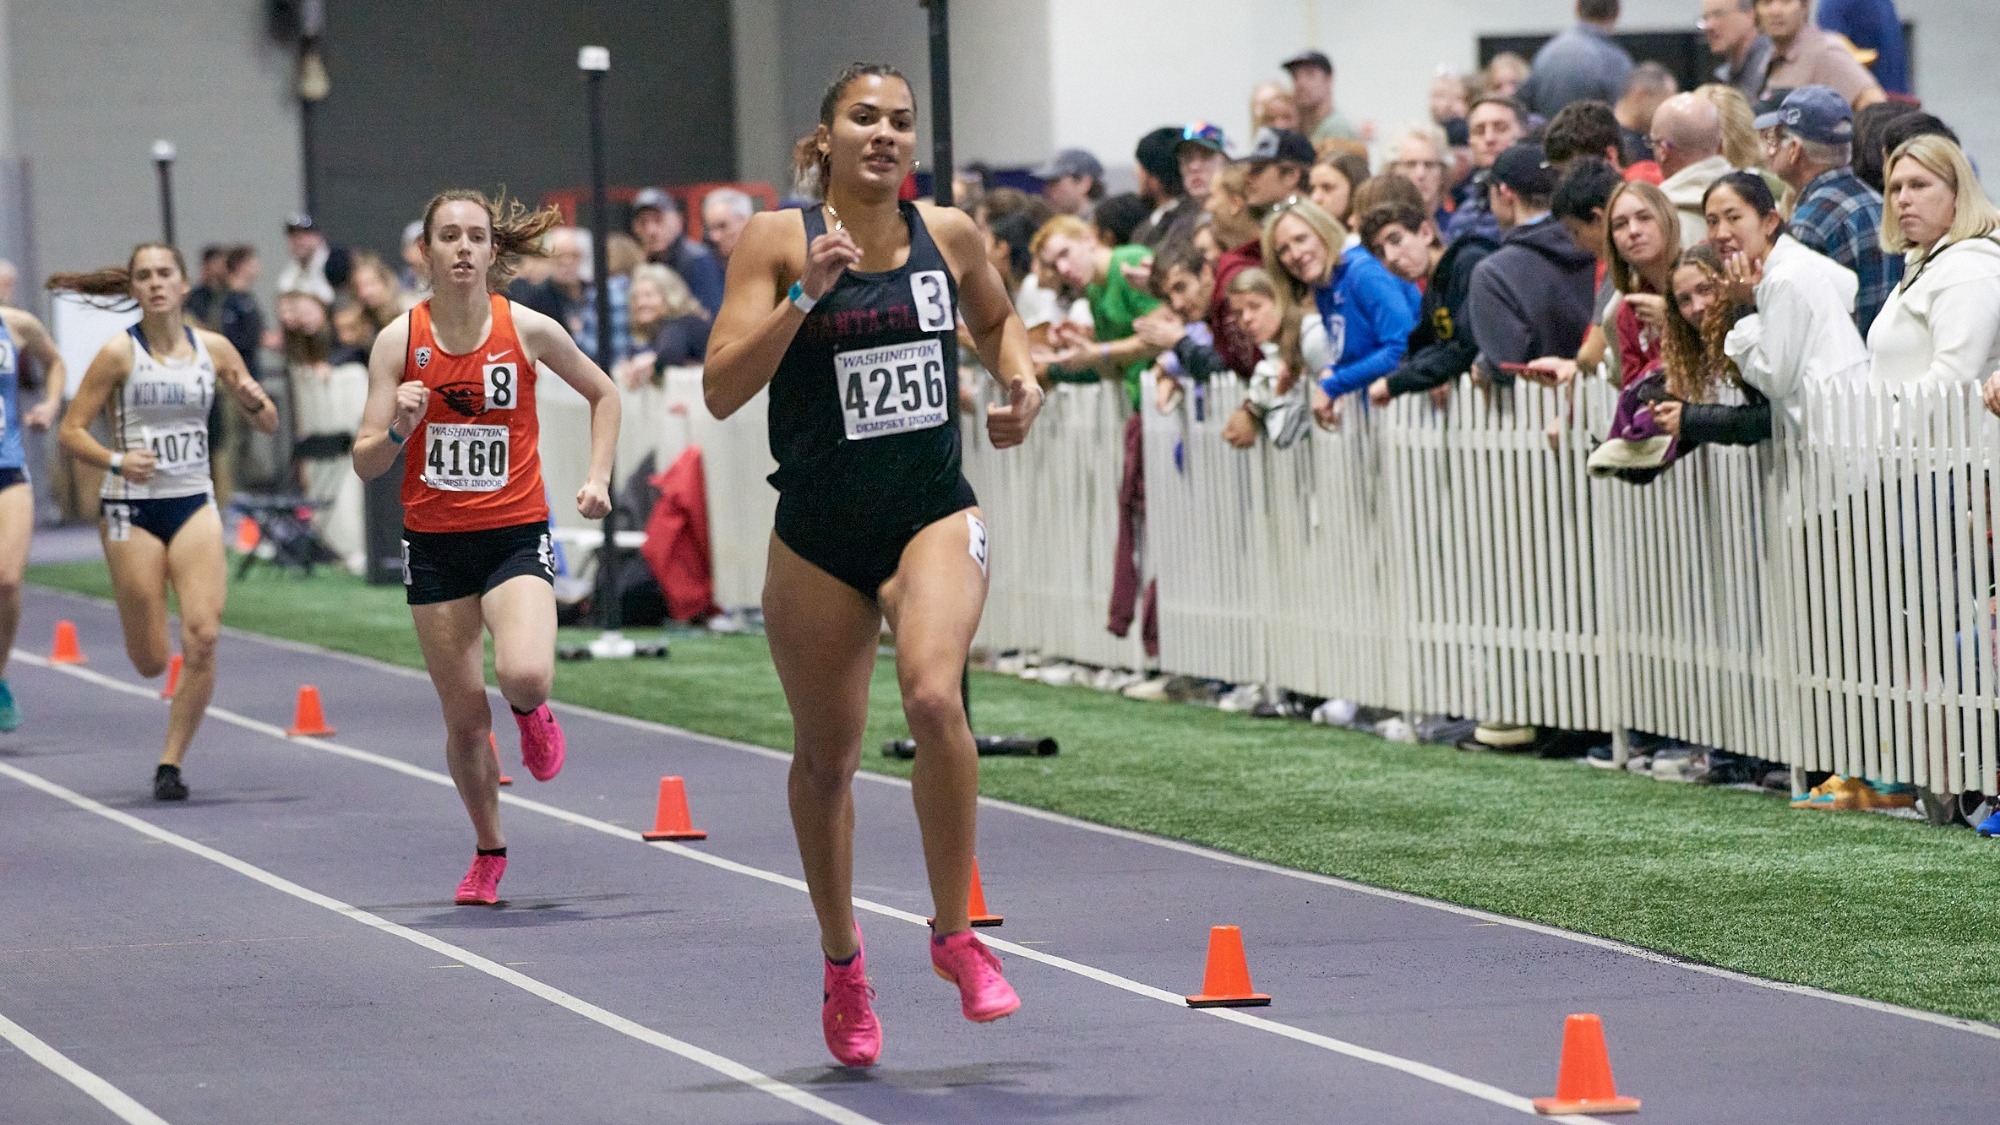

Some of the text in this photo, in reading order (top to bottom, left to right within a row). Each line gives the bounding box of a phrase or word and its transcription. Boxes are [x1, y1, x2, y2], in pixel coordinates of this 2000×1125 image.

[920, 275, 946, 327] 3
[196, 376, 206, 409] 1
[491, 366, 511, 407] 8
[846, 360, 943, 419] 4256
[856, 418, 904, 433] DEMPSEY
[152, 430, 206, 465] 4073
[428, 439, 507, 477] 4160
[471, 479, 503, 488] INDOOR
